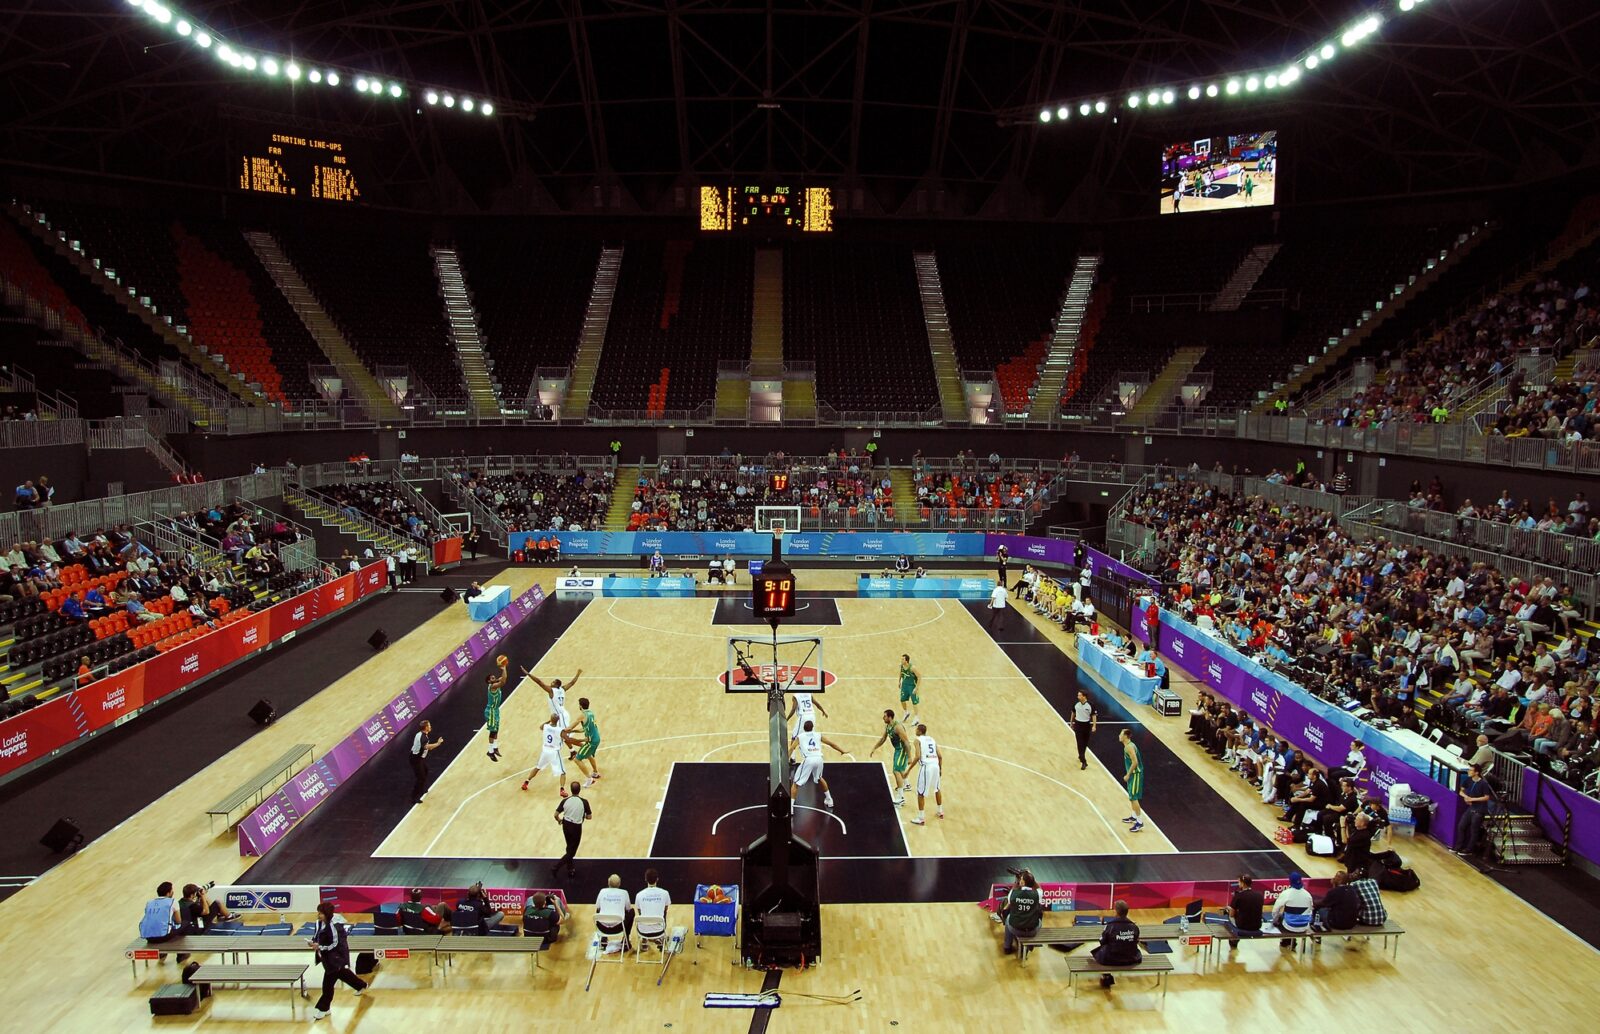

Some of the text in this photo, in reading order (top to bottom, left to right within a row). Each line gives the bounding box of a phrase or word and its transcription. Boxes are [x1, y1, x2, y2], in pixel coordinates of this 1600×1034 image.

[272, 134, 342, 151] STARTING LINE-UPS
[268, 146, 282, 155] FRA
[333, 155, 346, 164] AUS
[252, 170, 278, 180] PARKER
[322, 166, 343, 175] MILLS
[745, 186, 760, 194] FRA
[775, 186, 790, 194] AUS
[784, 207, 790, 215] 2
[765, 580, 791, 592] 9:10
[769, 592, 787, 607] 11
[106, 686, 125, 701] London
[102, 695, 125, 711] Prepares
[801, 699, 812, 709] 15
[1166, 700, 1180, 708] FIBA
[1308, 722, 1324, 740] London
[2, 731, 27, 748] London
[546, 734, 553, 744] 9
[808, 738, 816, 747] 4
[1303, 727, 1323, 747] Prepares
[0, 740, 28, 758] repares
[928, 743, 935, 754] 5
[1375, 765, 1397, 785] London
[299, 772, 320, 790] London
[300, 780, 325, 802] Prepares
[258, 805, 280, 824] London
[260, 812, 286, 838] Prepares
[488, 891, 521, 902] London
[1042, 886, 1072, 897] ondon
[269, 896, 288, 904] VISA
[1015, 897, 1035, 905] PHOTO
[1040, 897, 1072, 908] epares
[490, 902, 522, 911] epares
[699, 914, 730, 923] molten
